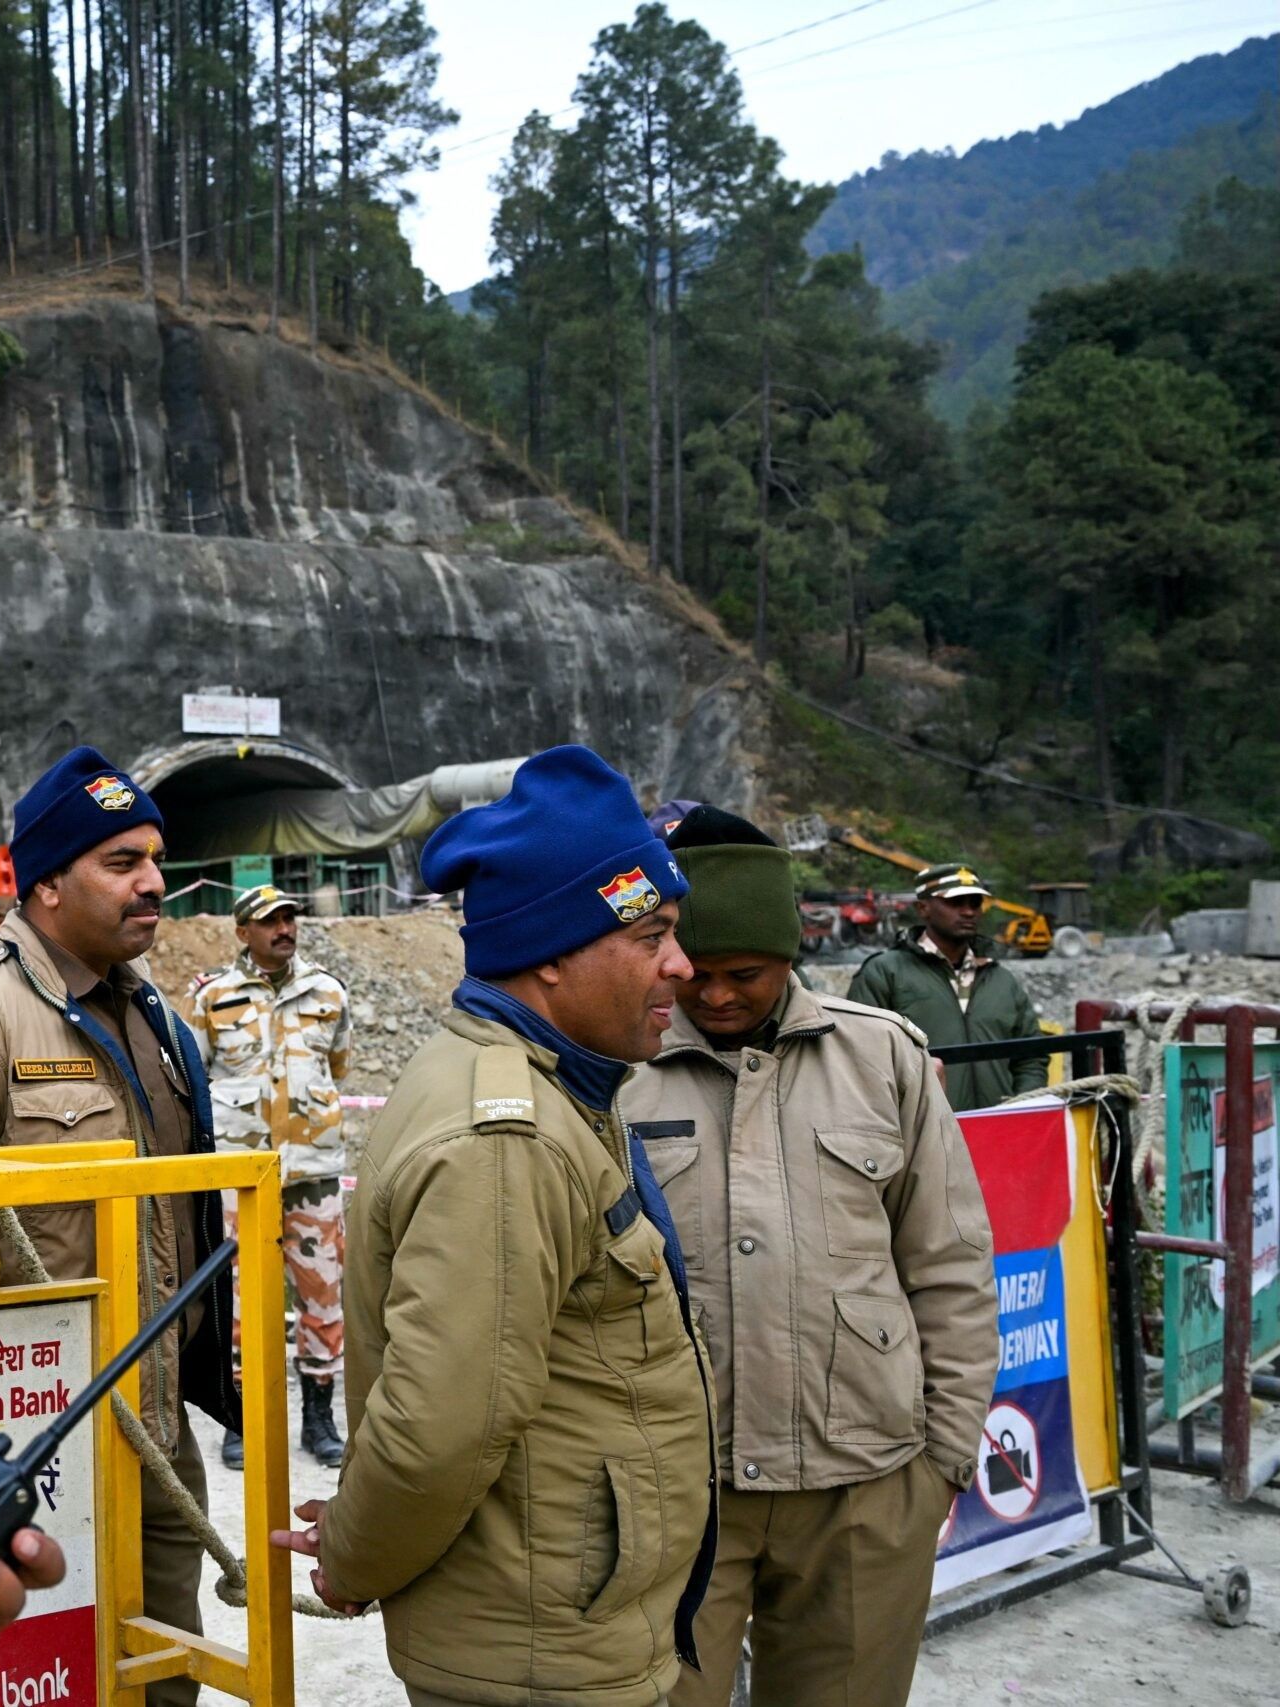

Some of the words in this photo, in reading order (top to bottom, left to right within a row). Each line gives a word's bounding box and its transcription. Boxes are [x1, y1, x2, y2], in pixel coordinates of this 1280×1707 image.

[20, 1064, 54, 1074] NEERAJ
[55, 1063, 92, 1073] GULERIA
[31, 1340, 61, 1369] का
[10, 1379, 70, 1419] Bank
[1, 1657, 70, 1707] bank
